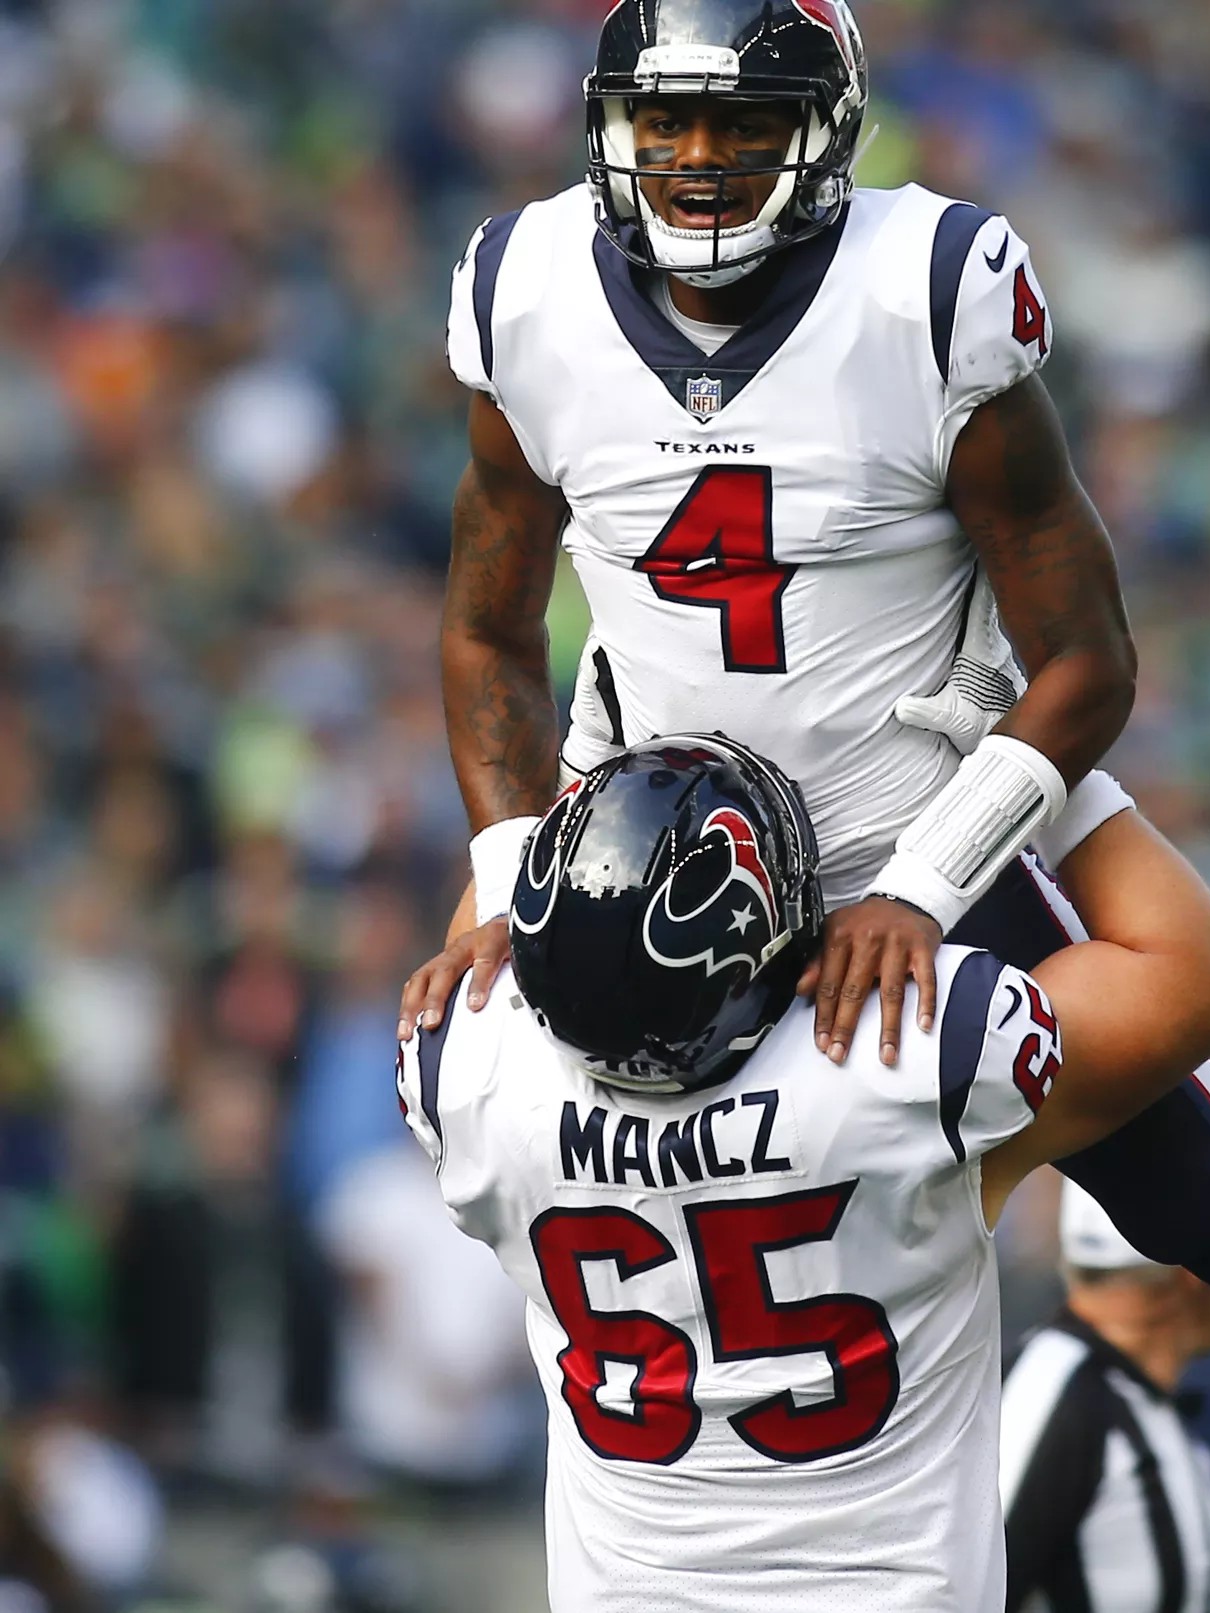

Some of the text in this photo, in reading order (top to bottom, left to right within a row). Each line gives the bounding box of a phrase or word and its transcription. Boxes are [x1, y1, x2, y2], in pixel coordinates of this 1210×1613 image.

[1011, 262, 1048, 360] 4
[653, 440, 756, 454] TEXANS
[692, 396, 716, 412] NFL
[633, 464, 798, 674] 4
[559, 1088, 794, 1188] MANCZ
[529, 1178, 902, 1467] 65
